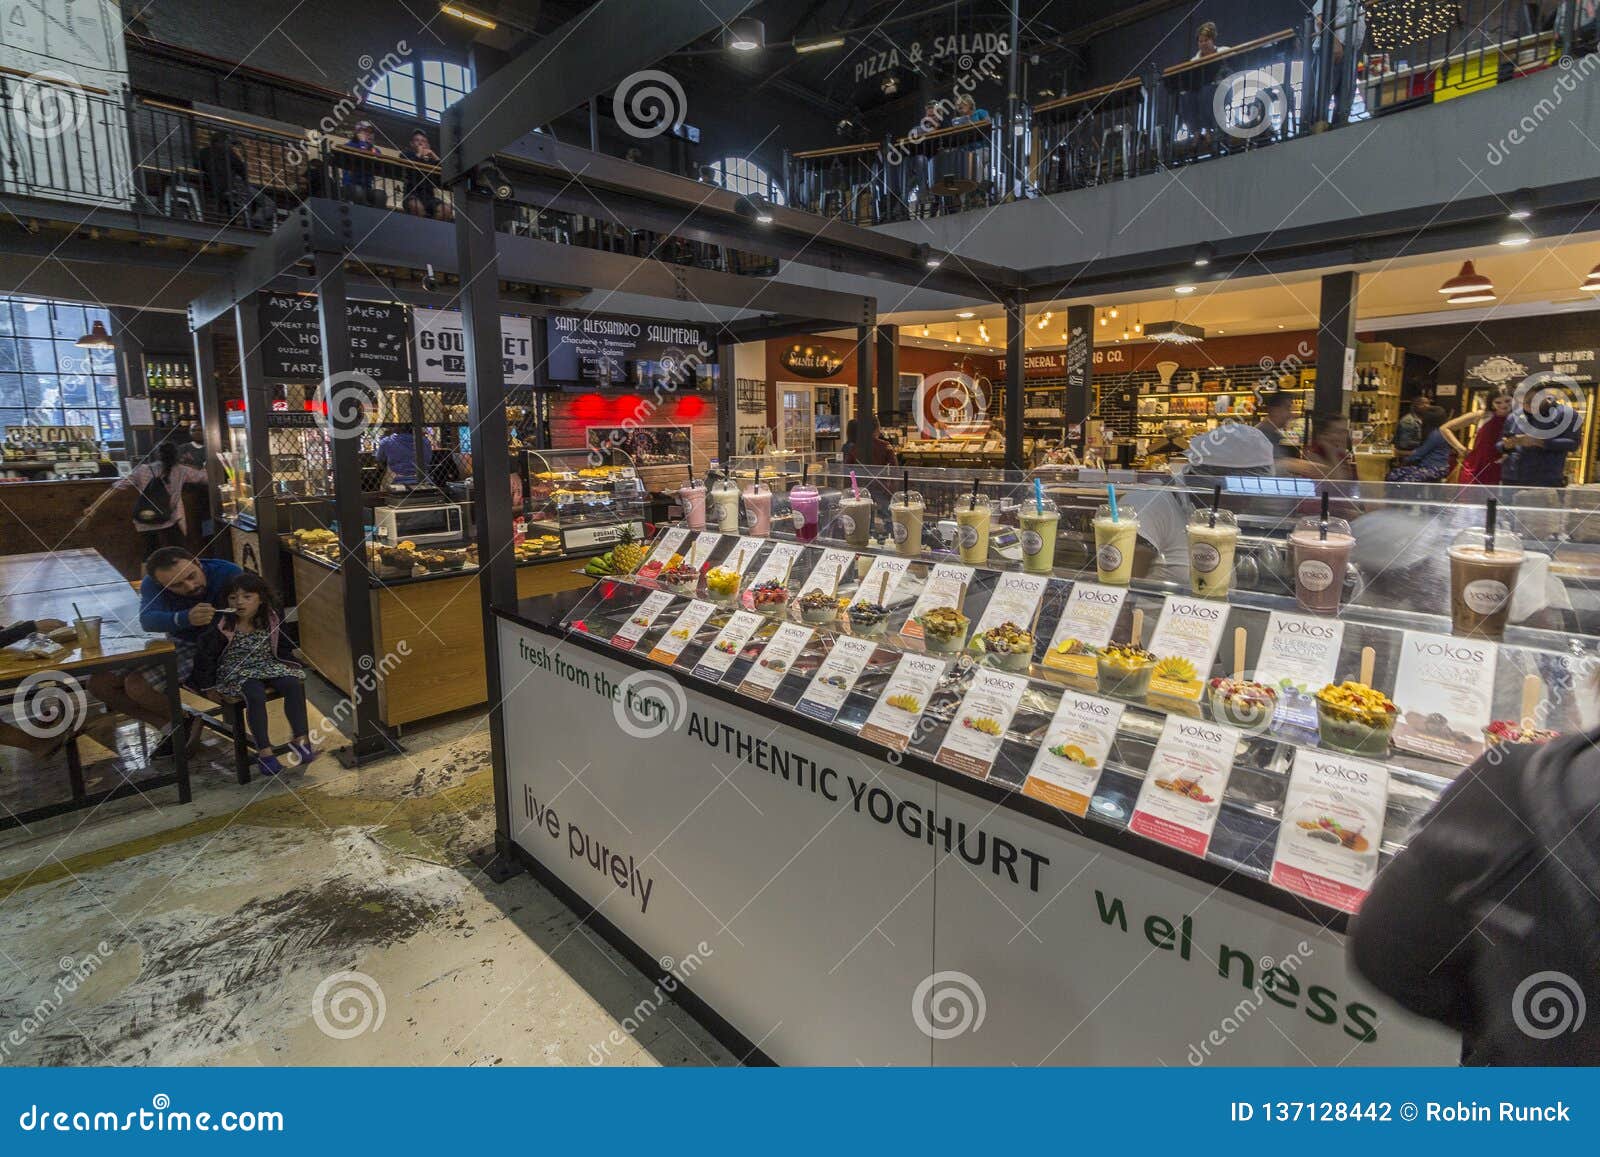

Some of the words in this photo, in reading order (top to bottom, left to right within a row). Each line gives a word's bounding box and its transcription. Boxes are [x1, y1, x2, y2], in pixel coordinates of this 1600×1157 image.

[855, 50, 900, 82] PIZZA
[909, 42, 923, 63] &
[269, 297, 320, 312] ARTISA
[299, 334, 320, 345] HO
[583, 319, 641, 337] ALESSANDRO
[647, 325, 700, 345] SALUMERIA
[352, 367, 381, 377] AKES
[1023, 355, 1056, 369] ENERAL
[1107, 350, 1125, 362] CO.
[519, 638, 551, 672] fresh
[554, 653, 590, 689] from
[594, 671, 622, 703] the
[688, 711, 838, 803] AUTHENTIC
[847, 776, 1050, 893] YOGHURT
[523, 783, 560, 839] live
[568, 823, 654, 914] purely
